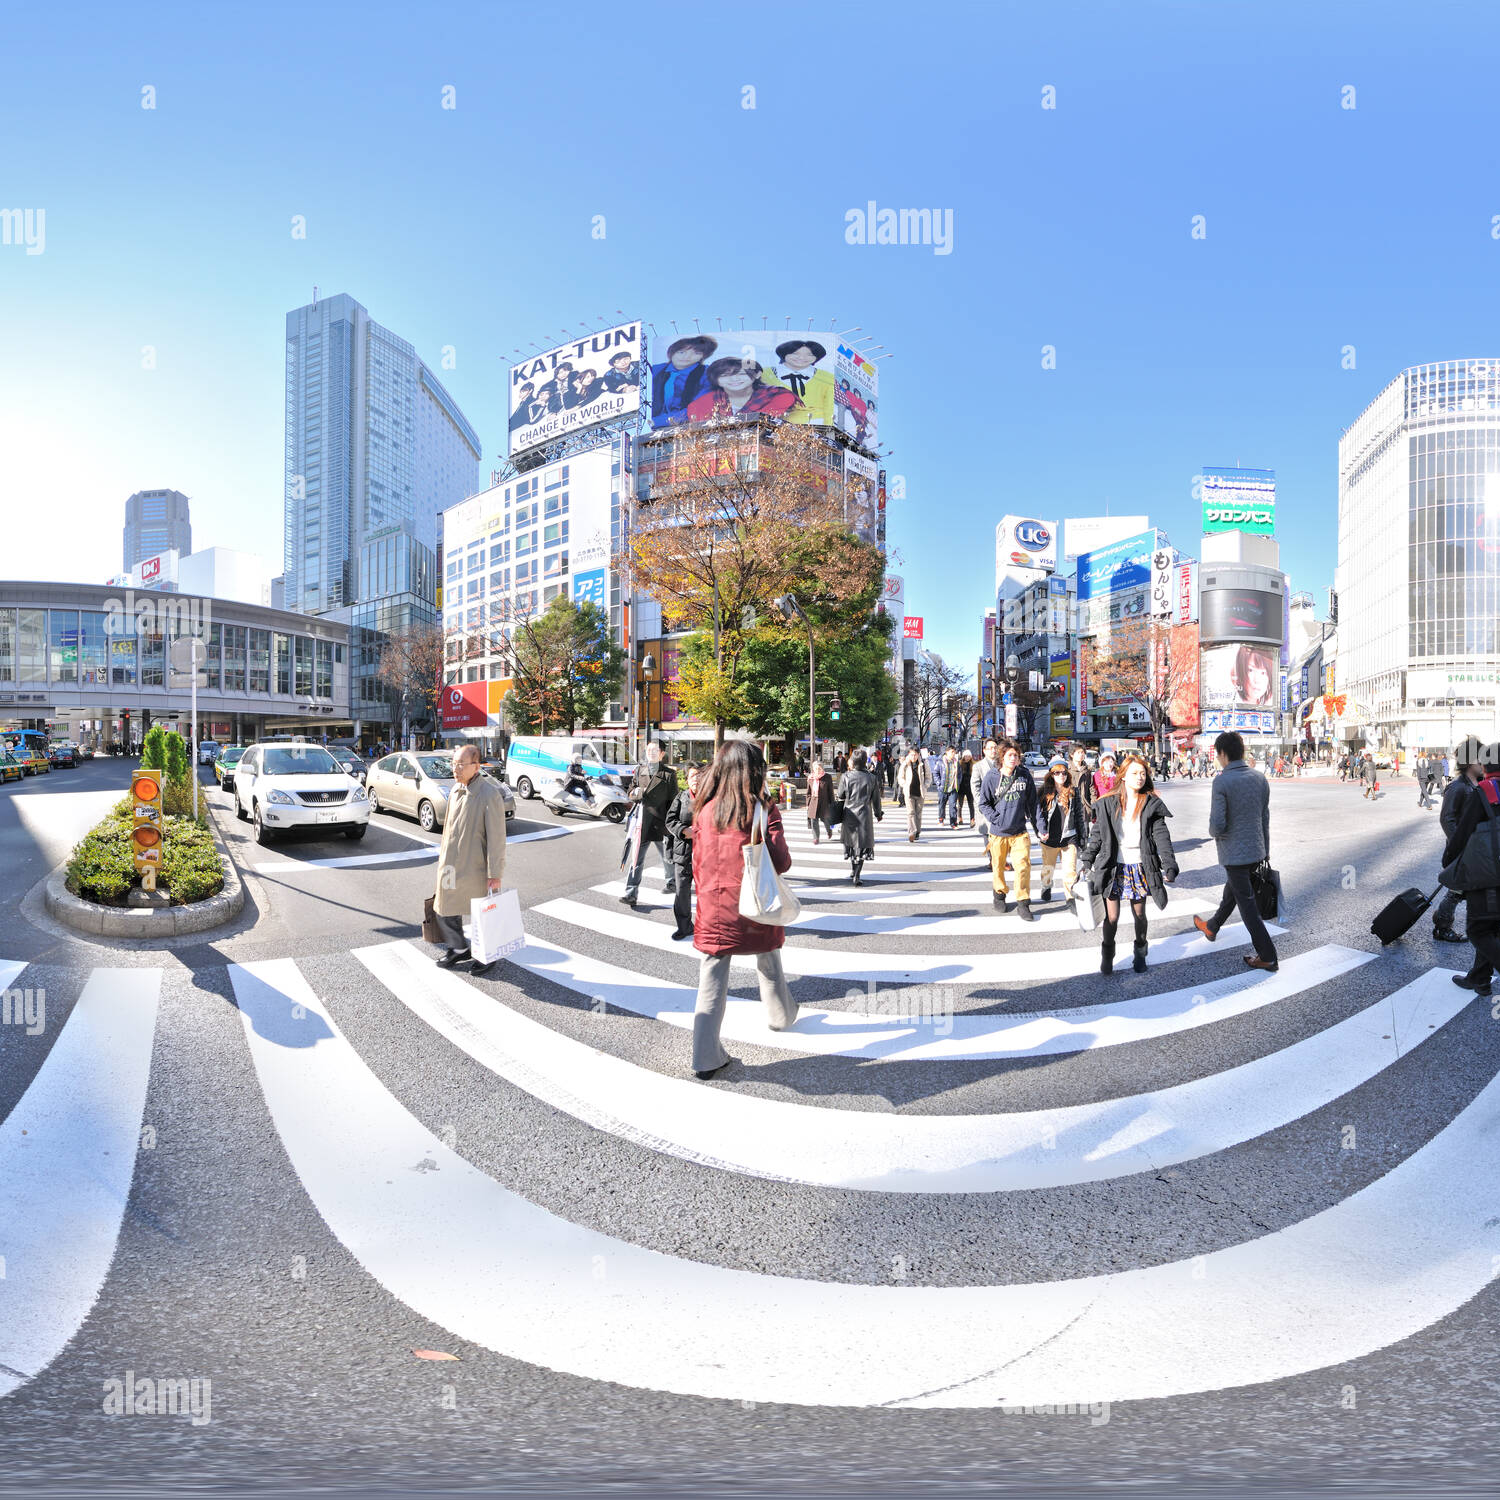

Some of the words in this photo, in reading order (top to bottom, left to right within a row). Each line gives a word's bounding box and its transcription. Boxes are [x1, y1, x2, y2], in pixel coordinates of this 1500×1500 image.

[513, 326, 636, 386] KAT-TUN
[837, 344, 876, 377] NYC
[519, 419, 559, 443] CHANGE
[562, 413, 577, 426] UR
[580, 397, 625, 419] WORLD
[1206, 509, 1273, 525] サロンパス
[1154, 551, 1170, 610] もんじゃ
